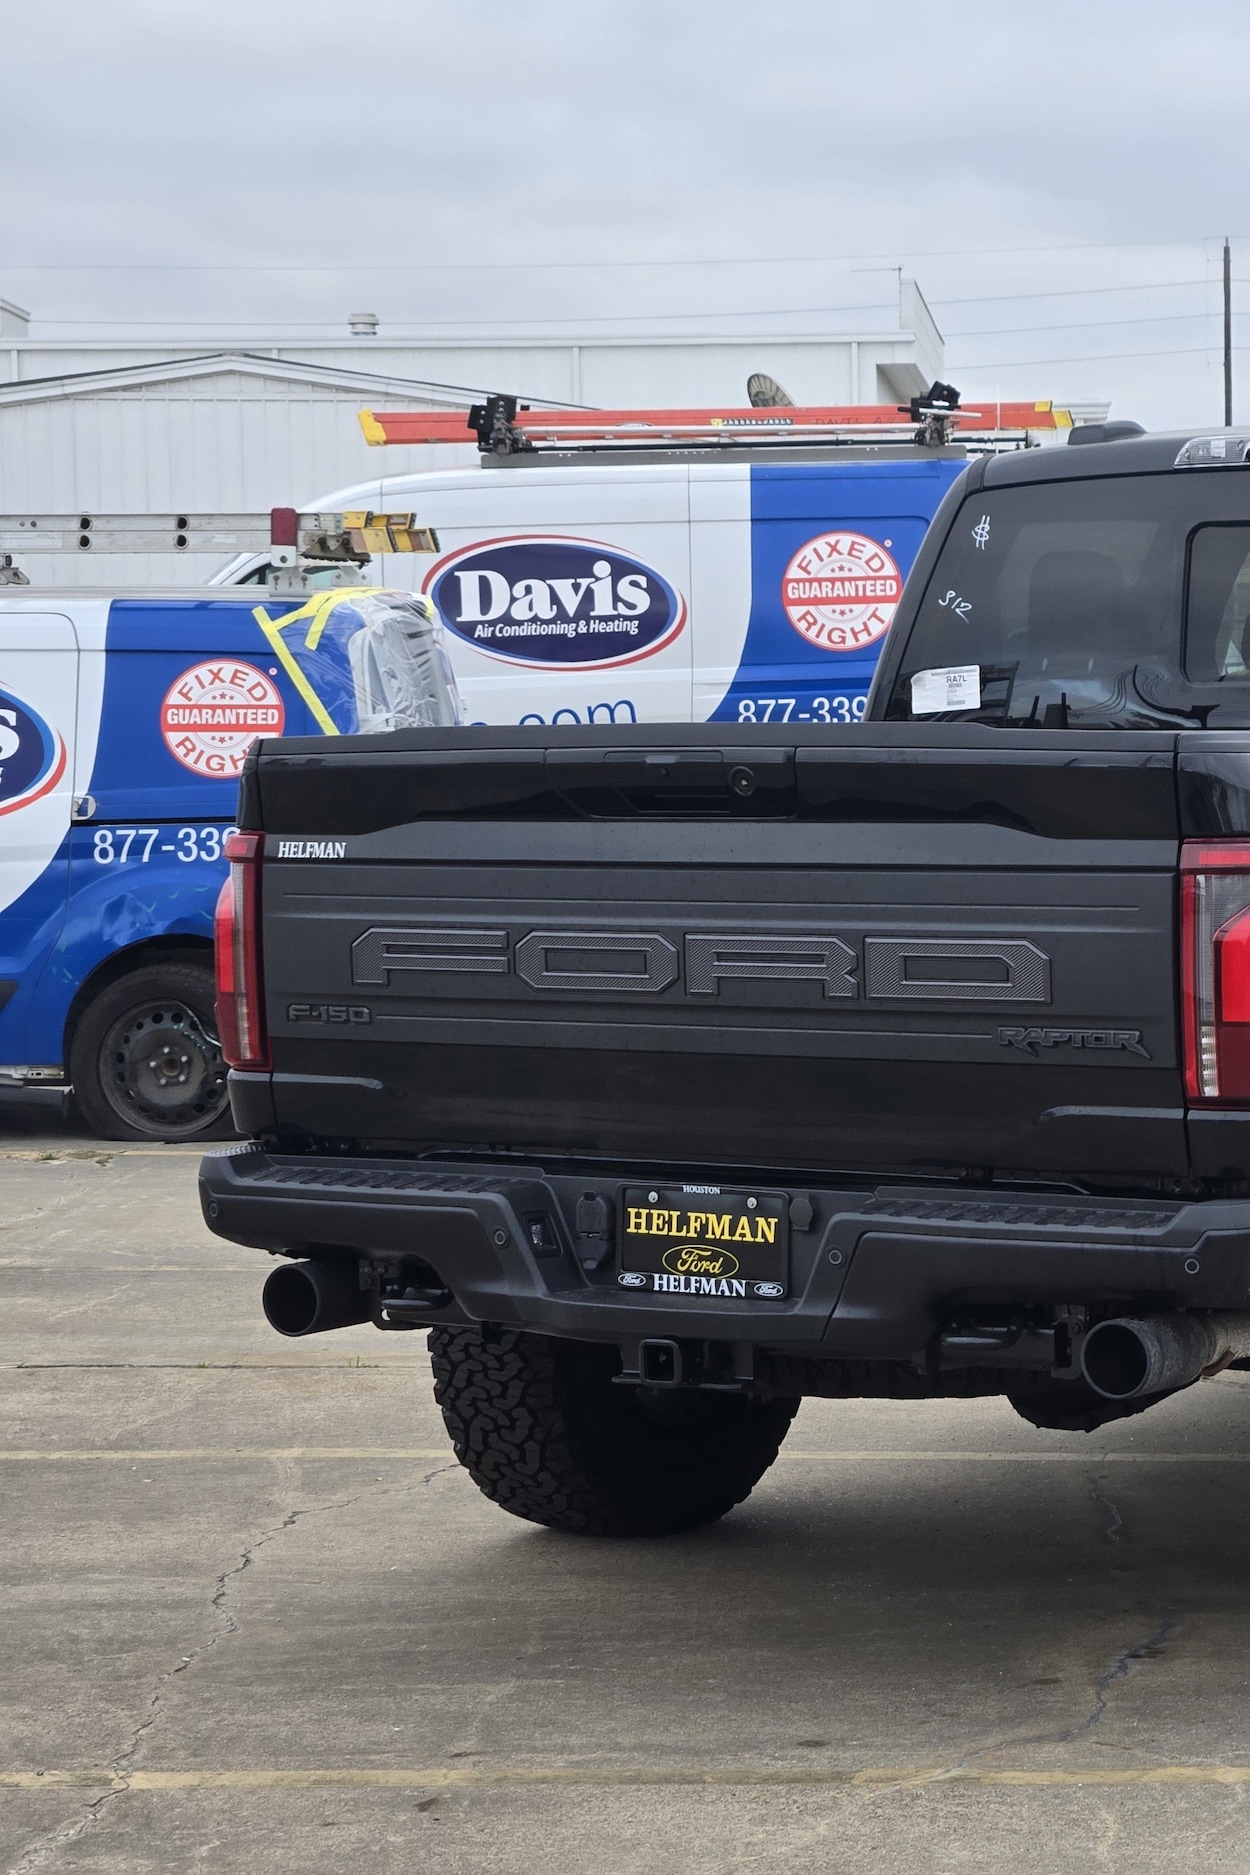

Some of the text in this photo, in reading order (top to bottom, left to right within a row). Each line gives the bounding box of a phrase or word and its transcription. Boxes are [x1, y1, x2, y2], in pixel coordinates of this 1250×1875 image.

[797, 539, 885, 576] FIXED
[454, 560, 651, 622] Davis
[787, 579, 898, 599] GUARANTEED
[474, 617, 640, 638] Air Conditioning & Heating
[797, 607, 886, 645] RIGHT
[177, 667, 268, 702] FIXED
[166, 708, 280, 725] GUARANTEED
[175, 735, 259, 772] RIGH
[277, 841, 347, 859] HELFMAN
[351, 926, 1053, 1004] FORD
[287, 1003, 372, 1023] F-150
[997, 1025, 1153, 1060] RAPTOR
[682, 1184, 721, 1195] HOUSTON
[626, 1207, 779, 1243] HELFMAN
[676, 1248, 723, 1275] Ford
[621, 1272, 780, 1297] Ford HELFMAN Ford
